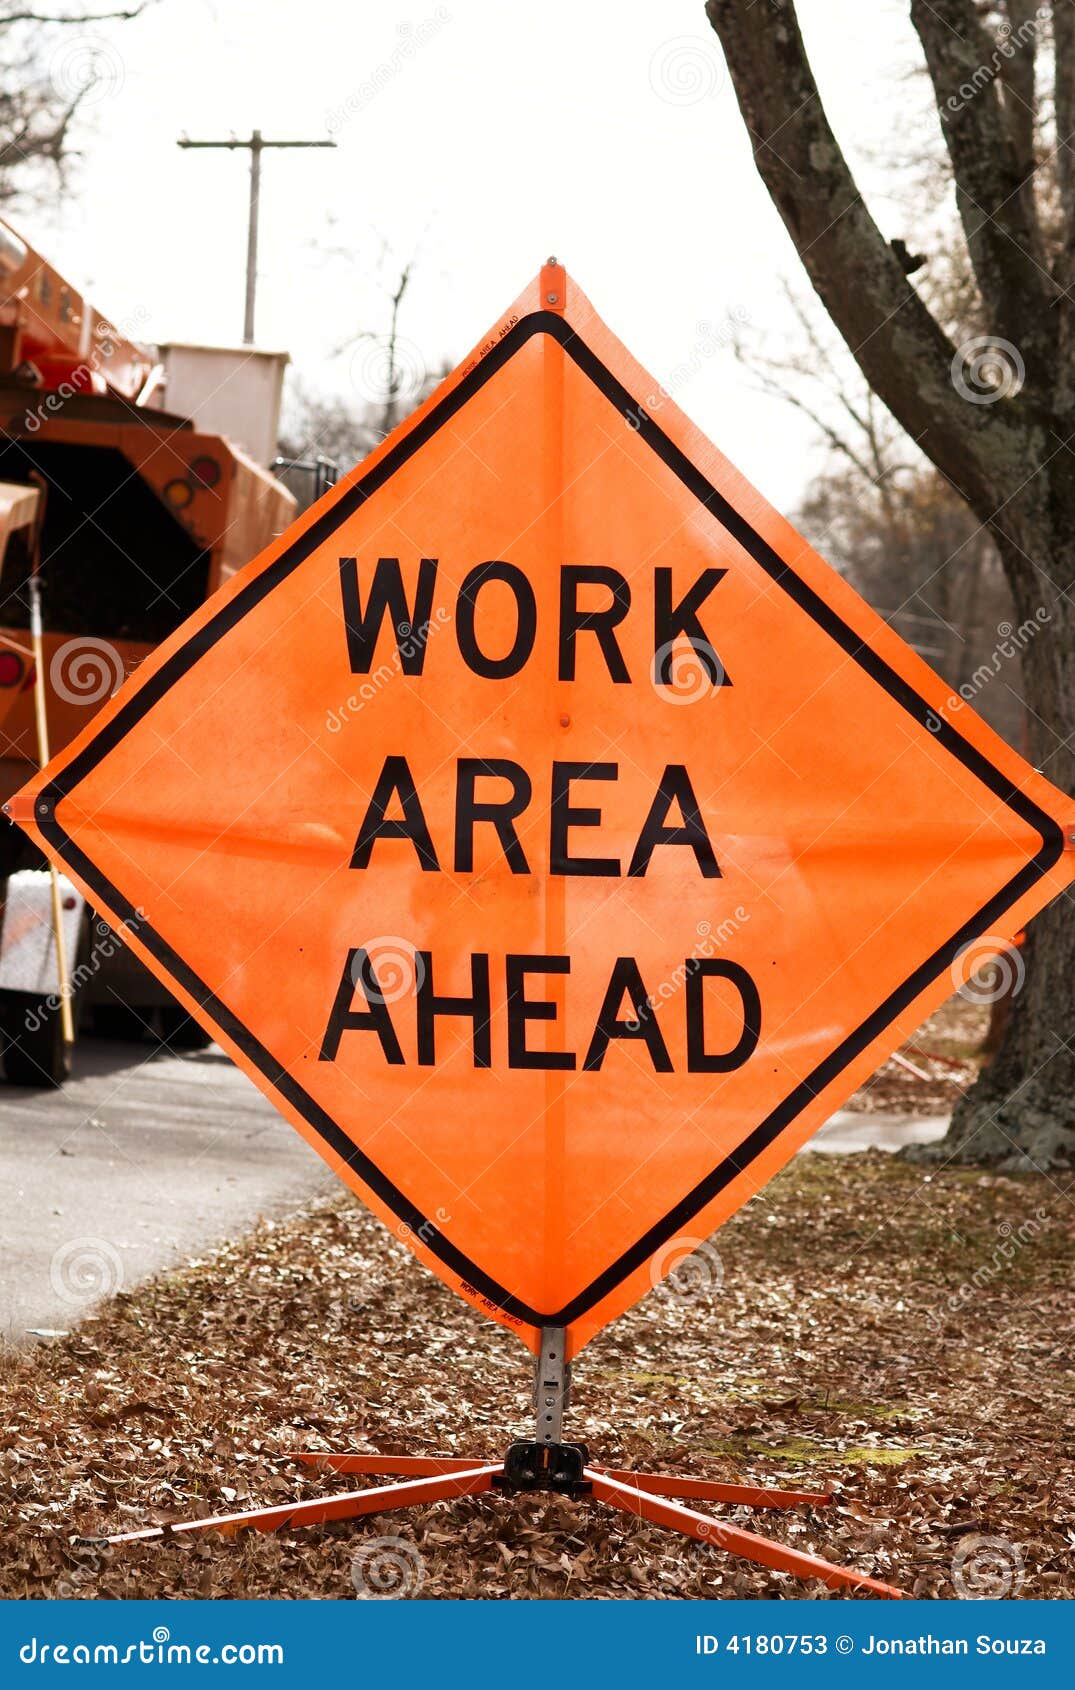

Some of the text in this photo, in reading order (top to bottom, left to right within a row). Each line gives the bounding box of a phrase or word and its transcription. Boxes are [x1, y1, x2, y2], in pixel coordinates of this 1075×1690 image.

[499, 315, 519, 337] AHEAD
[340, 557, 733, 687] WORK
[350, 755, 723, 879] AREA
[318, 948, 762, 1073] AHEAD
[460, 1281, 479, 1297] WORK
[480, 1298, 498, 1312] AREA
